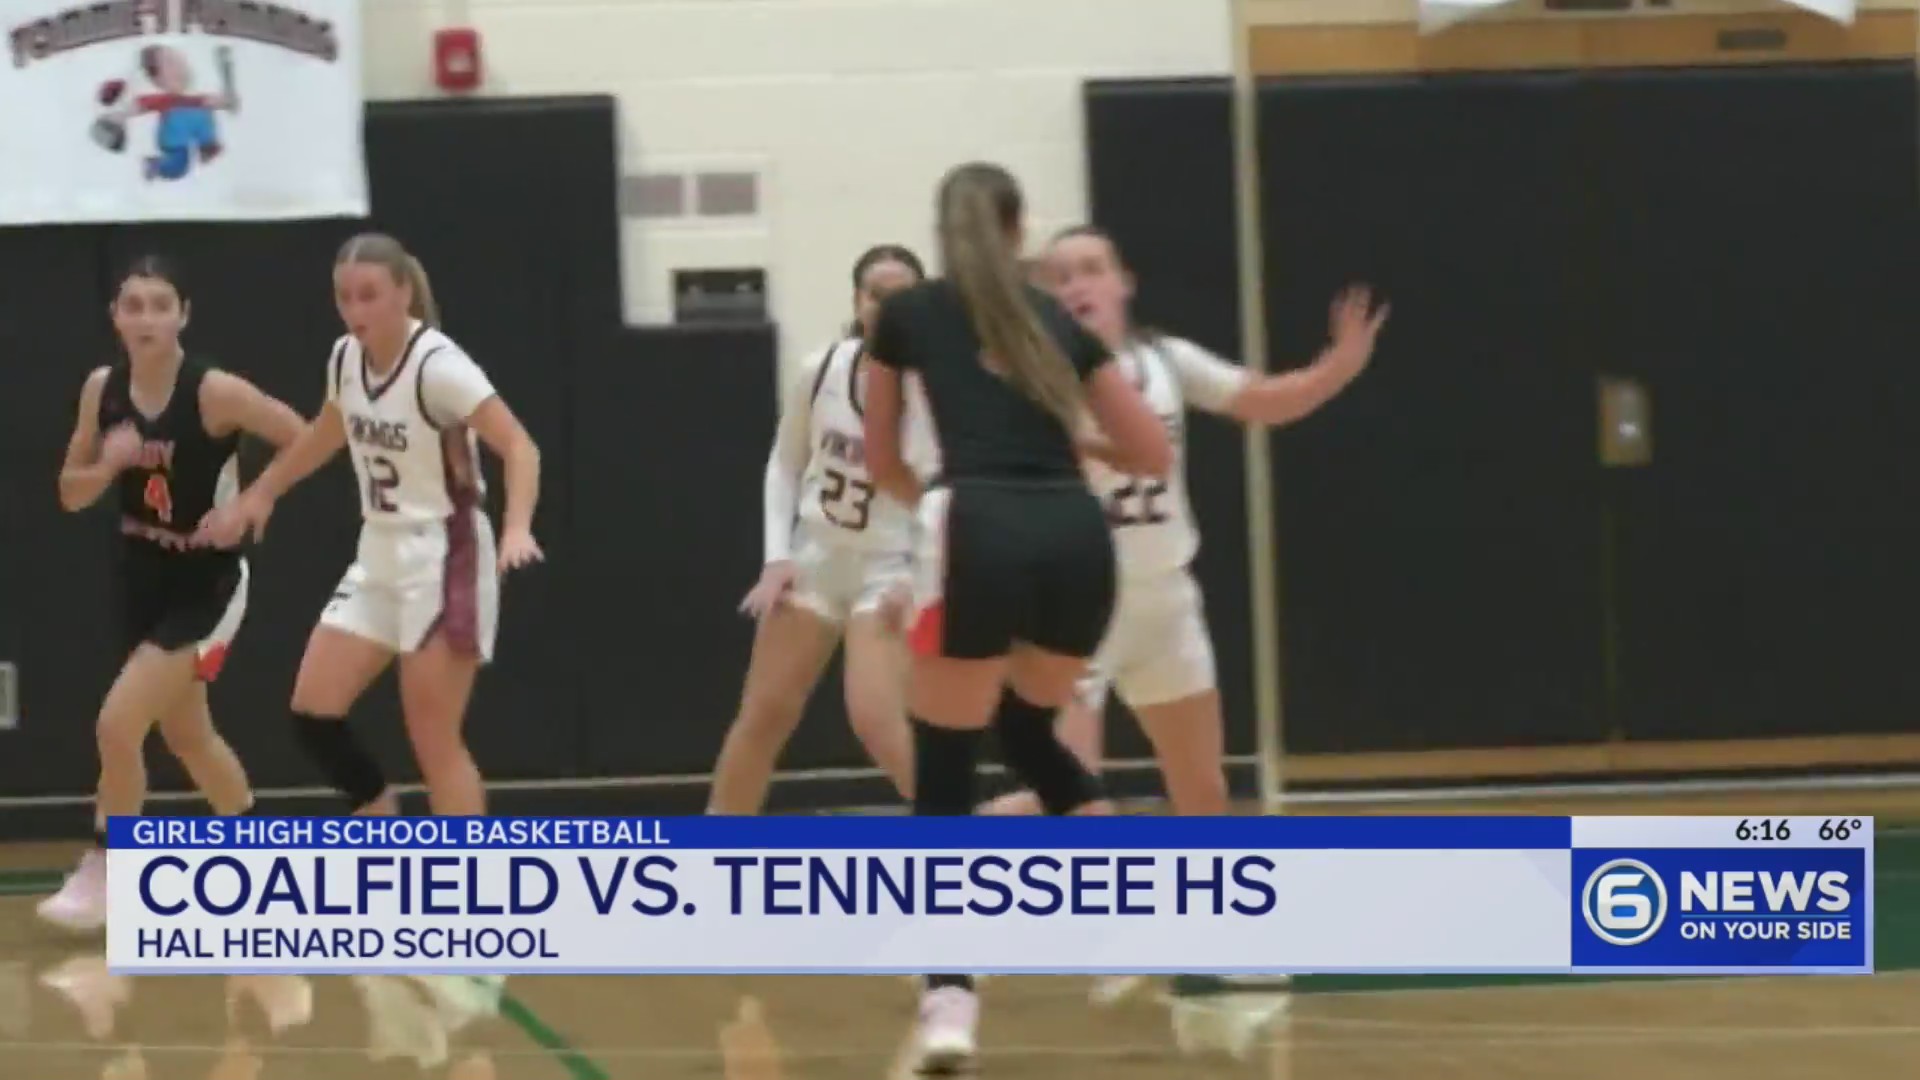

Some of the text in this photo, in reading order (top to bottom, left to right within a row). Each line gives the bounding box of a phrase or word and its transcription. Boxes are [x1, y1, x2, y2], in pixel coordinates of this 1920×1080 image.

[144, 474, 172, 521] 4
[363, 456, 400, 511] 12
[819, 467, 874, 531] 23
